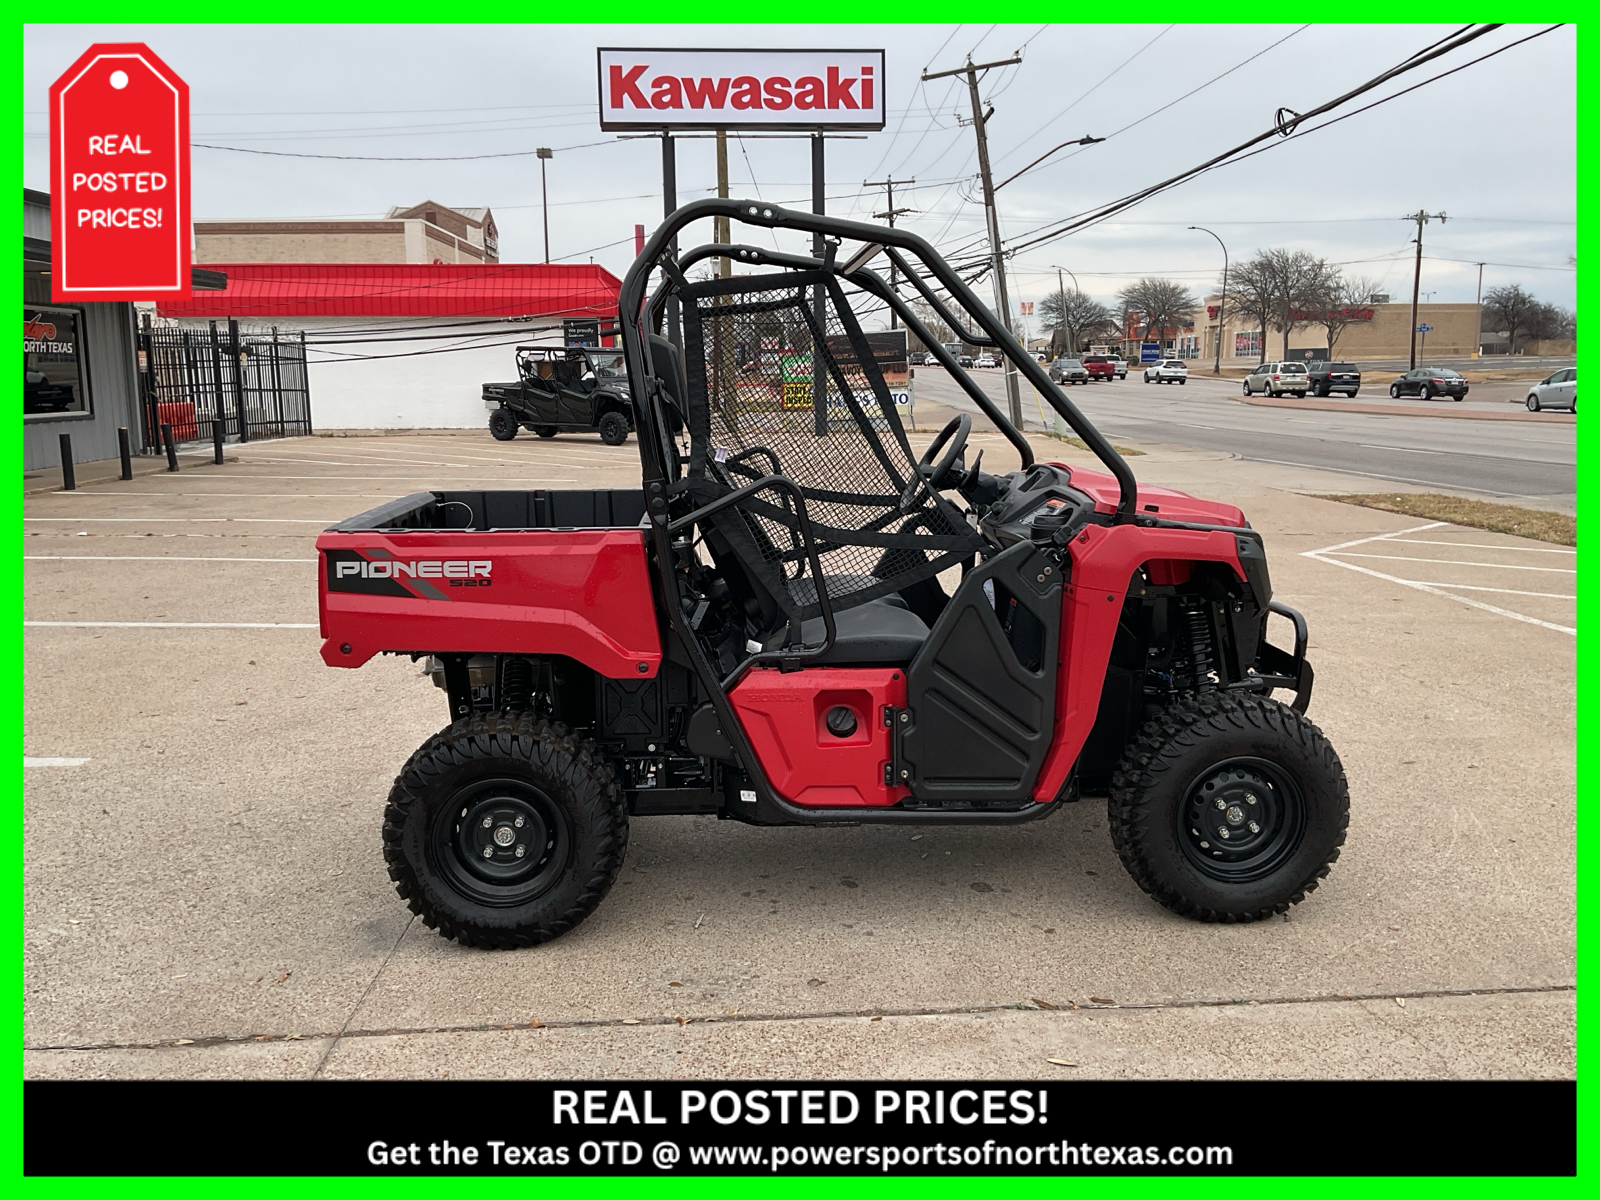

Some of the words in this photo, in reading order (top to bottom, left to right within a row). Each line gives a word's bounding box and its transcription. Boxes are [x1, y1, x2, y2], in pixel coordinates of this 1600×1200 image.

[608, 64, 875, 111] Kawasaki
[24, 341, 46, 353] ORTH
[47, 342, 73, 353] TEXAS
[336, 560, 493, 579] PIONEER
[449, 579, 492, 587] 520
[747, 693, 805, 703] HONDA
